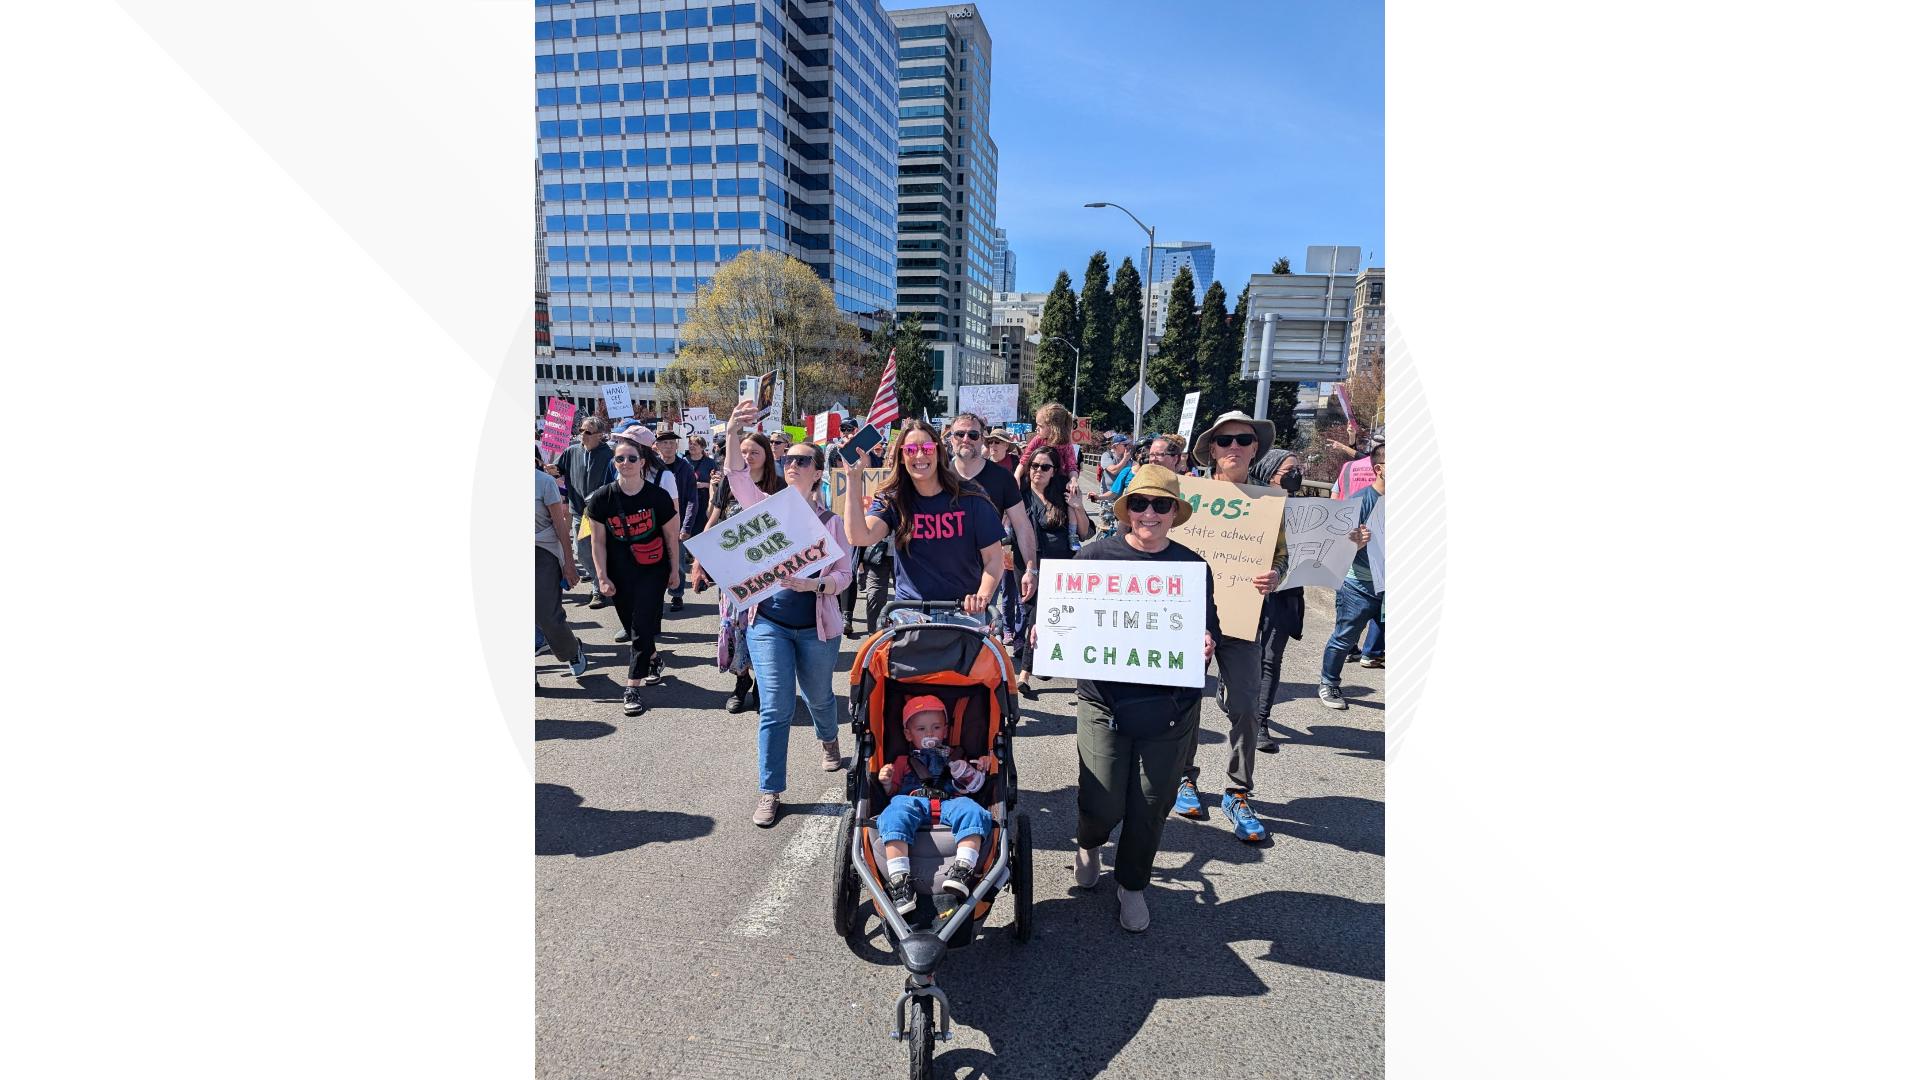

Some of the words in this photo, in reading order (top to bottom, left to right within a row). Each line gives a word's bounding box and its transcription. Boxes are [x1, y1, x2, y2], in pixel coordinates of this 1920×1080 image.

[949, 8, 972, 19] moda
[720, 511, 781, 551] SAVE
[913, 511, 965, 539] ESIST
[1184, 525, 1215, 538] state
[1284, 504, 1354, 536] NDS
[745, 531, 794, 563] OUR
[1213, 550, 1264, 565] impulsive
[729, 537, 829, 603] DEMOCRACY
[1055, 573, 1183, 597] IMPEACH
[1048, 605, 1075, 625] 3RD
[1094, 607, 1184, 631] TIME'S
[1050, 643, 1064, 661] A
[1083, 645, 1184, 670] CHARM
